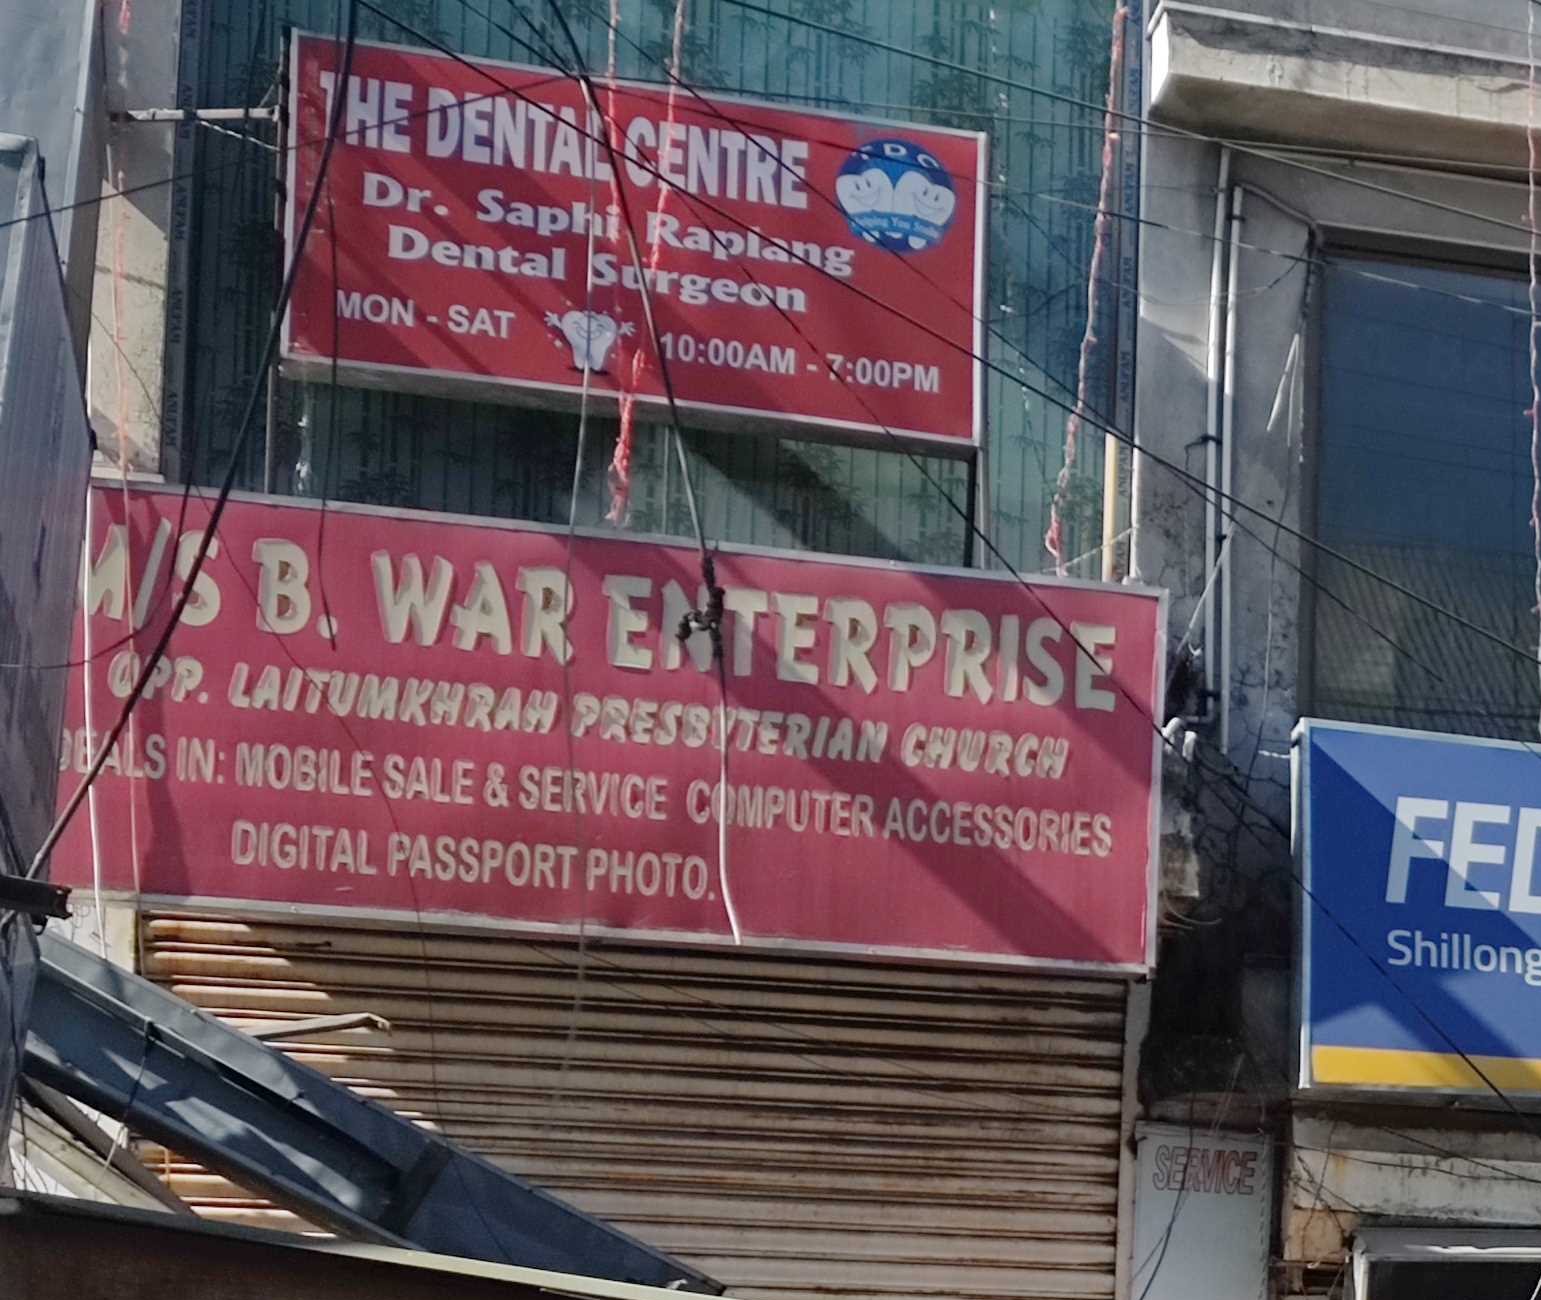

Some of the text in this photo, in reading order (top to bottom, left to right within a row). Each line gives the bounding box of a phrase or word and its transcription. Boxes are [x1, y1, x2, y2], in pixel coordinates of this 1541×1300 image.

[426, 86, 612, 182] DENTAL
[624, 116, 808, 209] CENTRE
[363, 171, 448, 216] Dr.
[477, 189, 620, 243] Saphi
[388, 225, 807, 313] Dental Surgeon
[337, 289, 515, 339] MON SAT
[661, 333, 940, 393] 10:00AM 7:00PM
[253, 538, 338, 640] B.
[372, 550, 575, 666] WAR
[603, 574, 1116, 712] ENTERPRISE
[228, 661, 558, 735] LAITUMKHRAH
[571, 692, 888, 765] PRESBYTERIAN
[900, 720, 1069, 780] CHURCH
[234, 743, 373, 798] MOBILE
[382, 755, 473, 805] SALE
[483, 763, 509, 808] &
[518, 765, 668, 822] SERVICE
[687, 778, 874, 838] COMPUTER
[883, 798, 1113, 859] ACCESSORIES
[232, 819, 716, 901] DIGITAL PASSPORT PHOTO.
[1152, 1144, 1258, 1195] SERVICE
